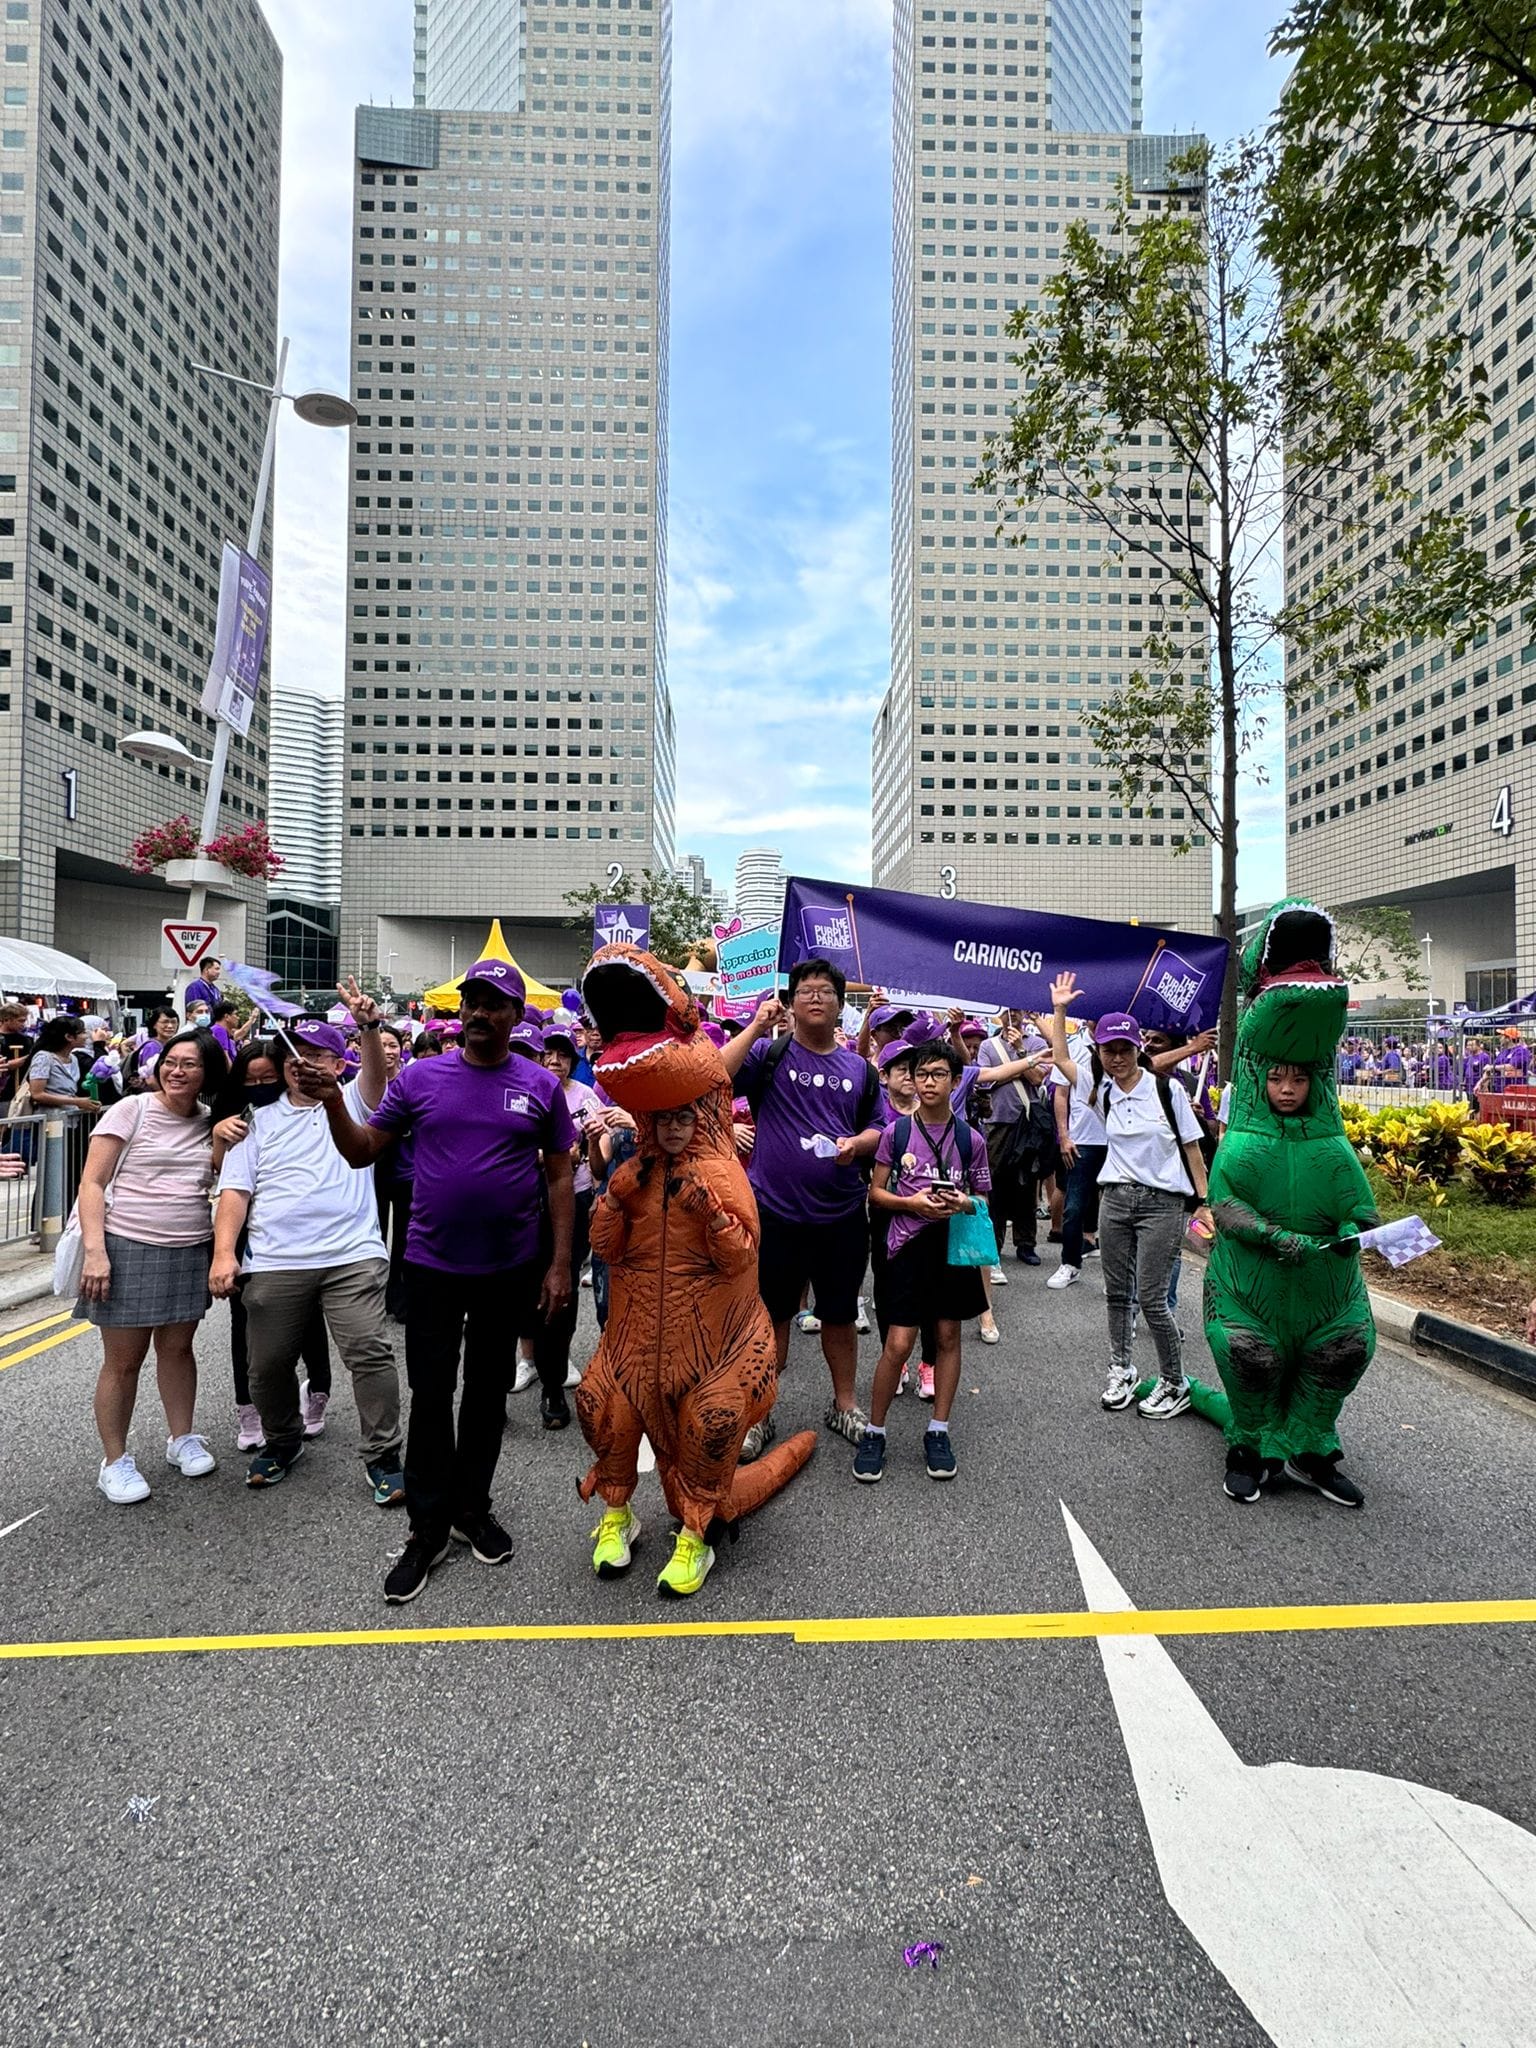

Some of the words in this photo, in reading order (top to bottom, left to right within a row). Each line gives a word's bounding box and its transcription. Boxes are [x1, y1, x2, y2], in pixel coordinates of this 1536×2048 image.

[62, 768, 77, 820] 1
[1491, 785, 1513, 836] 4
[607, 862, 623, 896] 2
[940, 865, 957, 900] 3
[814, 925, 849, 938] PURPLE
[830, 917, 847, 929] THE
[181, 931, 201, 942] GIVE
[609, 929, 633, 944] 106
[816, 934, 850, 947] PARADE
[953, 940, 1042, 974] CARINGSG
[721, 972, 735, 984] No
[736, 964, 772, 981] matter
[1161, 971, 1195, 1002] PURPLE
[1180, 974, 1200, 992] THE
[1157, 980, 1190, 1010] PARADE
